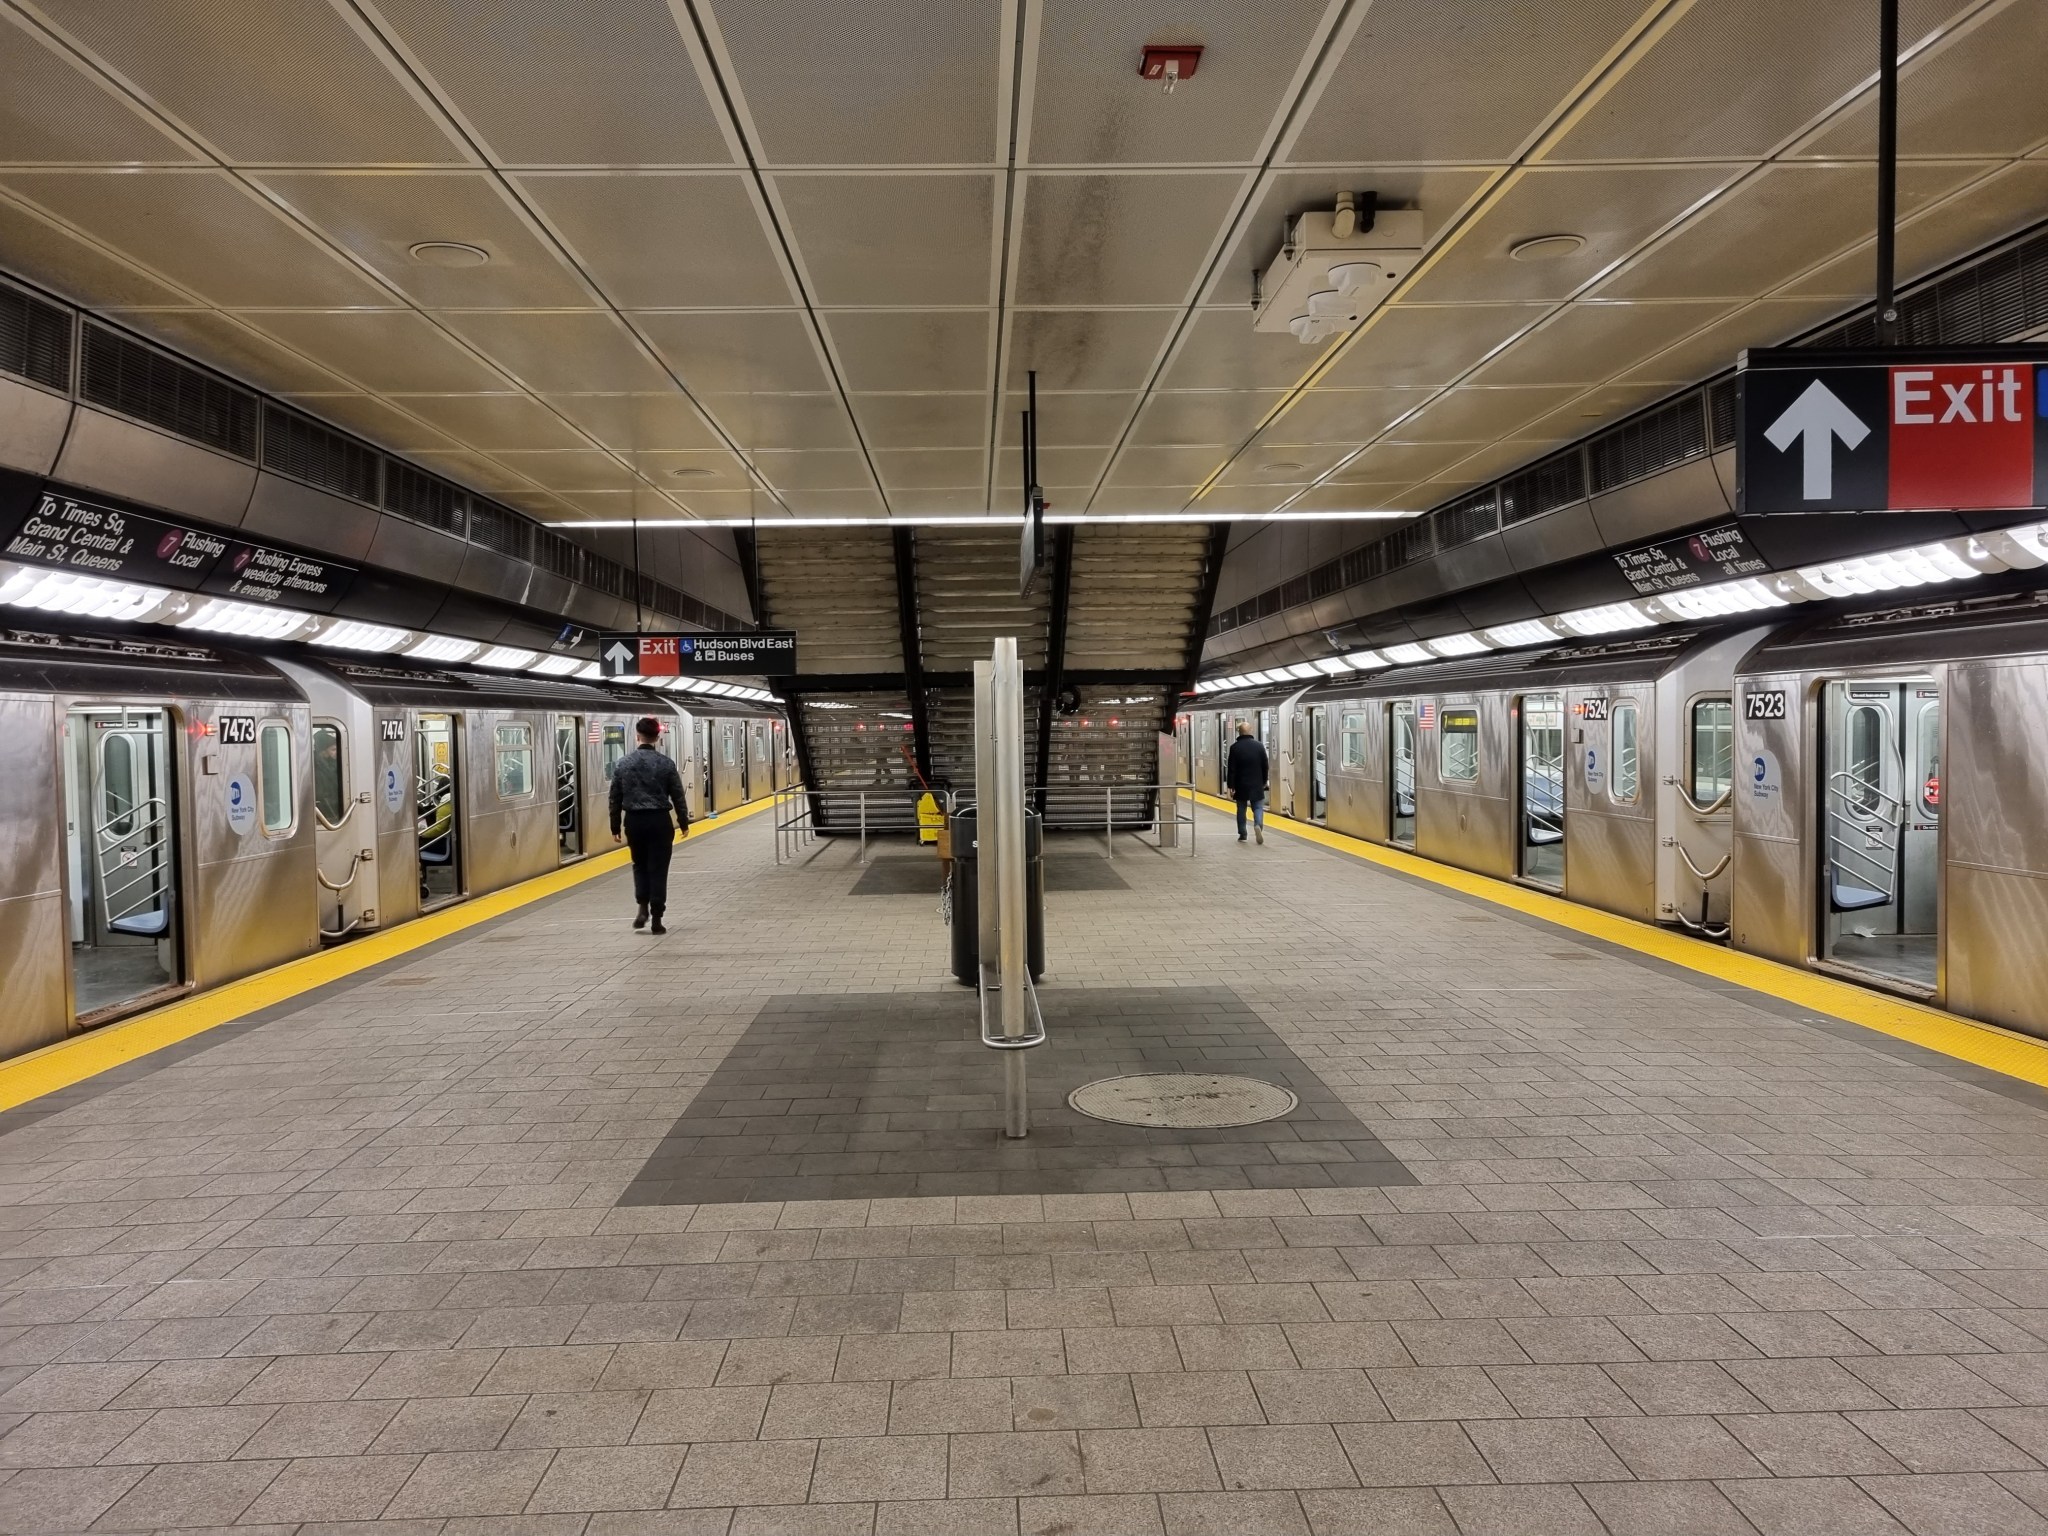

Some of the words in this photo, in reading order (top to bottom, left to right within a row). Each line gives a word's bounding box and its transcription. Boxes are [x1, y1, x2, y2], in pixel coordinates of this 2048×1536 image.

[1894, 369, 2022, 424] Exit
[39, 496, 57, 516] To
[60, 502, 101, 527] Times
[104, 513, 125, 535] Sq,
[23, 517, 67, 541] Grand
[71, 530, 118, 552] Central
[120, 539, 135, 554] &
[160, 537, 178, 553] 7
[181, 532, 226, 557] Flushing
[1700, 529, 1743, 548] Flushing
[6, 537, 46, 557] Main
[47, 543, 66, 563] St,
[71, 549, 123, 571] Queens
[169, 551, 206, 569] Local
[236, 553, 249, 568] 7
[1614, 556, 1628, 568] To
[1624, 551, 1651, 566] Times
[1650, 547, 1668, 561] Sq,
[1693, 543, 1704, 557] 7
[1708, 545, 1741, 562] Local
[251, 549, 290, 574] Flushing
[289, 557, 324, 578] Express
[1624, 566, 1650, 581] Grand
[1648, 560, 1679, 577] Central
[1675, 558, 1688, 570] &
[1722, 561, 1736, 575] all
[1733, 558, 1766, 574] times
[229, 580, 240, 593] &
[240, 583, 282, 601] evenings
[242, 567, 283, 587] weekday
[282, 574, 328, 594] afternoons
[1632, 579, 1656, 594] Main
[1653, 577, 1669, 590] St,
[1665, 571, 1700, 587] Queens
[639, 639, 676, 655] Exit
[693, 638, 738, 650] Hudson
[739, 638, 766, 650] Blvd
[766, 639, 794, 650] East
[694, 651, 703, 661] &
[718, 651, 755, 661] Buses
[1584, 699, 1607, 719] 7524
[1747, 692, 1785, 719] 7523
[221, 717, 255, 742] 7473
[381, 720, 404, 740] 7474
